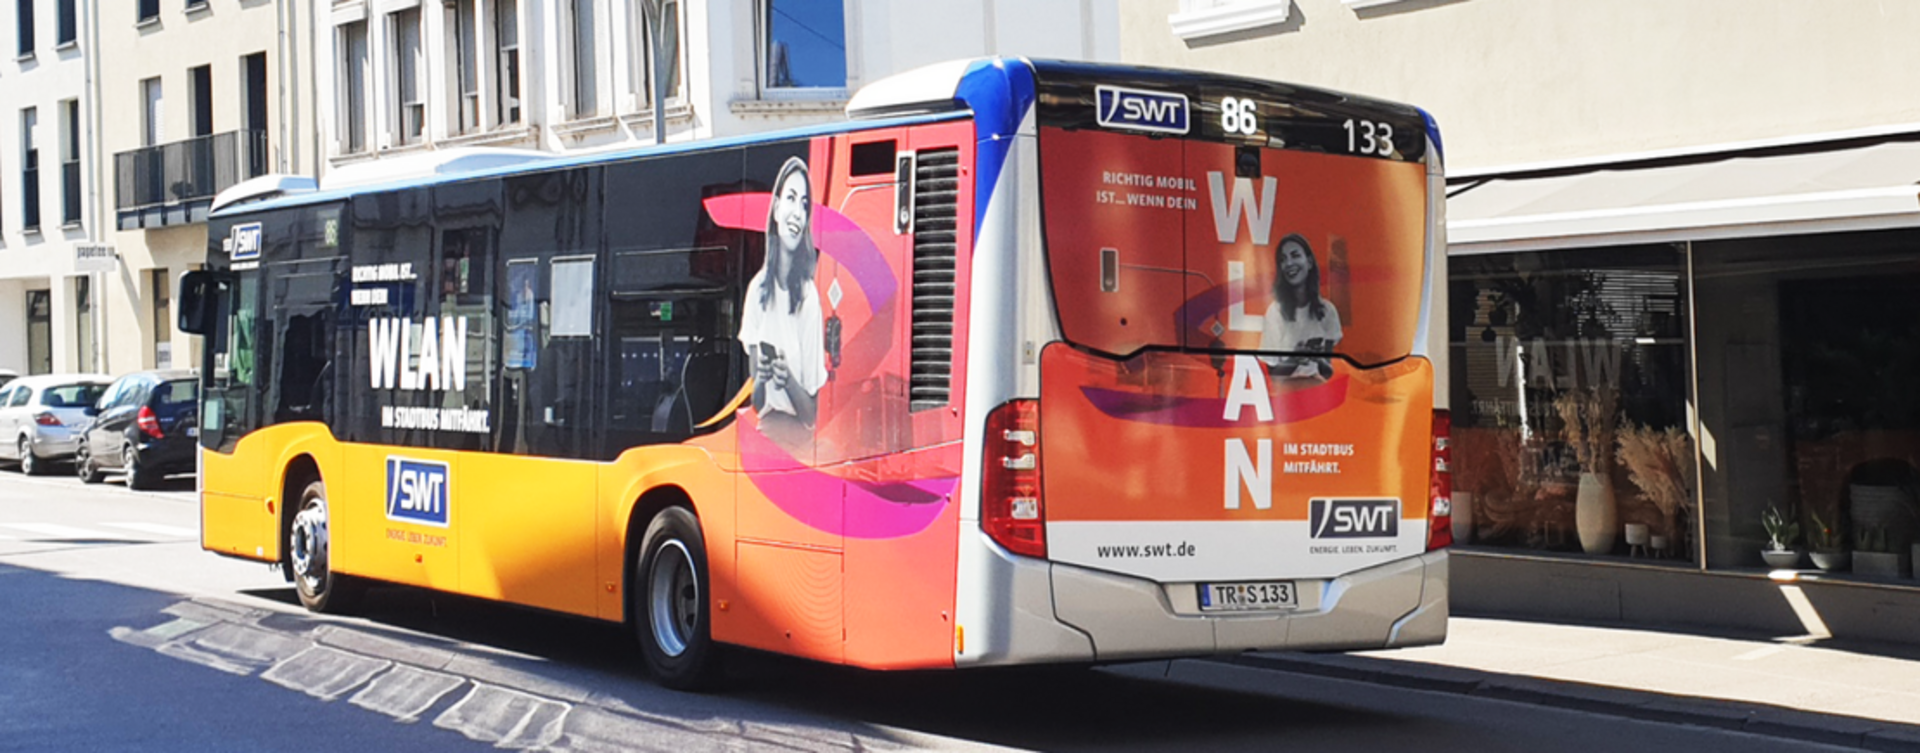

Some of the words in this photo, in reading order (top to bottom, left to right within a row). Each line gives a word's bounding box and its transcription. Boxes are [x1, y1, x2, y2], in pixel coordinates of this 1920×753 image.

[1122, 97, 1180, 124] SWT
[1219, 96, 1257, 134] 86
[1342, 118, 1394, 157] 133
[1103, 171, 1154, 188] RICHTIG
[1156, 176, 1197, 191] MOBIL
[1127, 193, 1165, 207] WENN
[1167, 196, 1197, 210] DEIN
[369, 315, 467, 392] WLAN
[382, 405, 394, 427] IM
[394, 406, 439, 430] STADTBUS
[440, 404, 490, 434] MITFÄHRT.
[1283, 443, 1298, 455] IM
[1300, 443, 1354, 456] STADTBUS
[1283, 459, 1342, 474] MITFÄHRT.
[401, 469, 444, 514] SWT
[1334, 506, 1393, 532] SWT
[1097, 541, 1196, 558] www.swt.de
[1215, 585, 1237, 604] TR
[1247, 585, 1257, 604] S
[1260, 584, 1289, 604] 133
